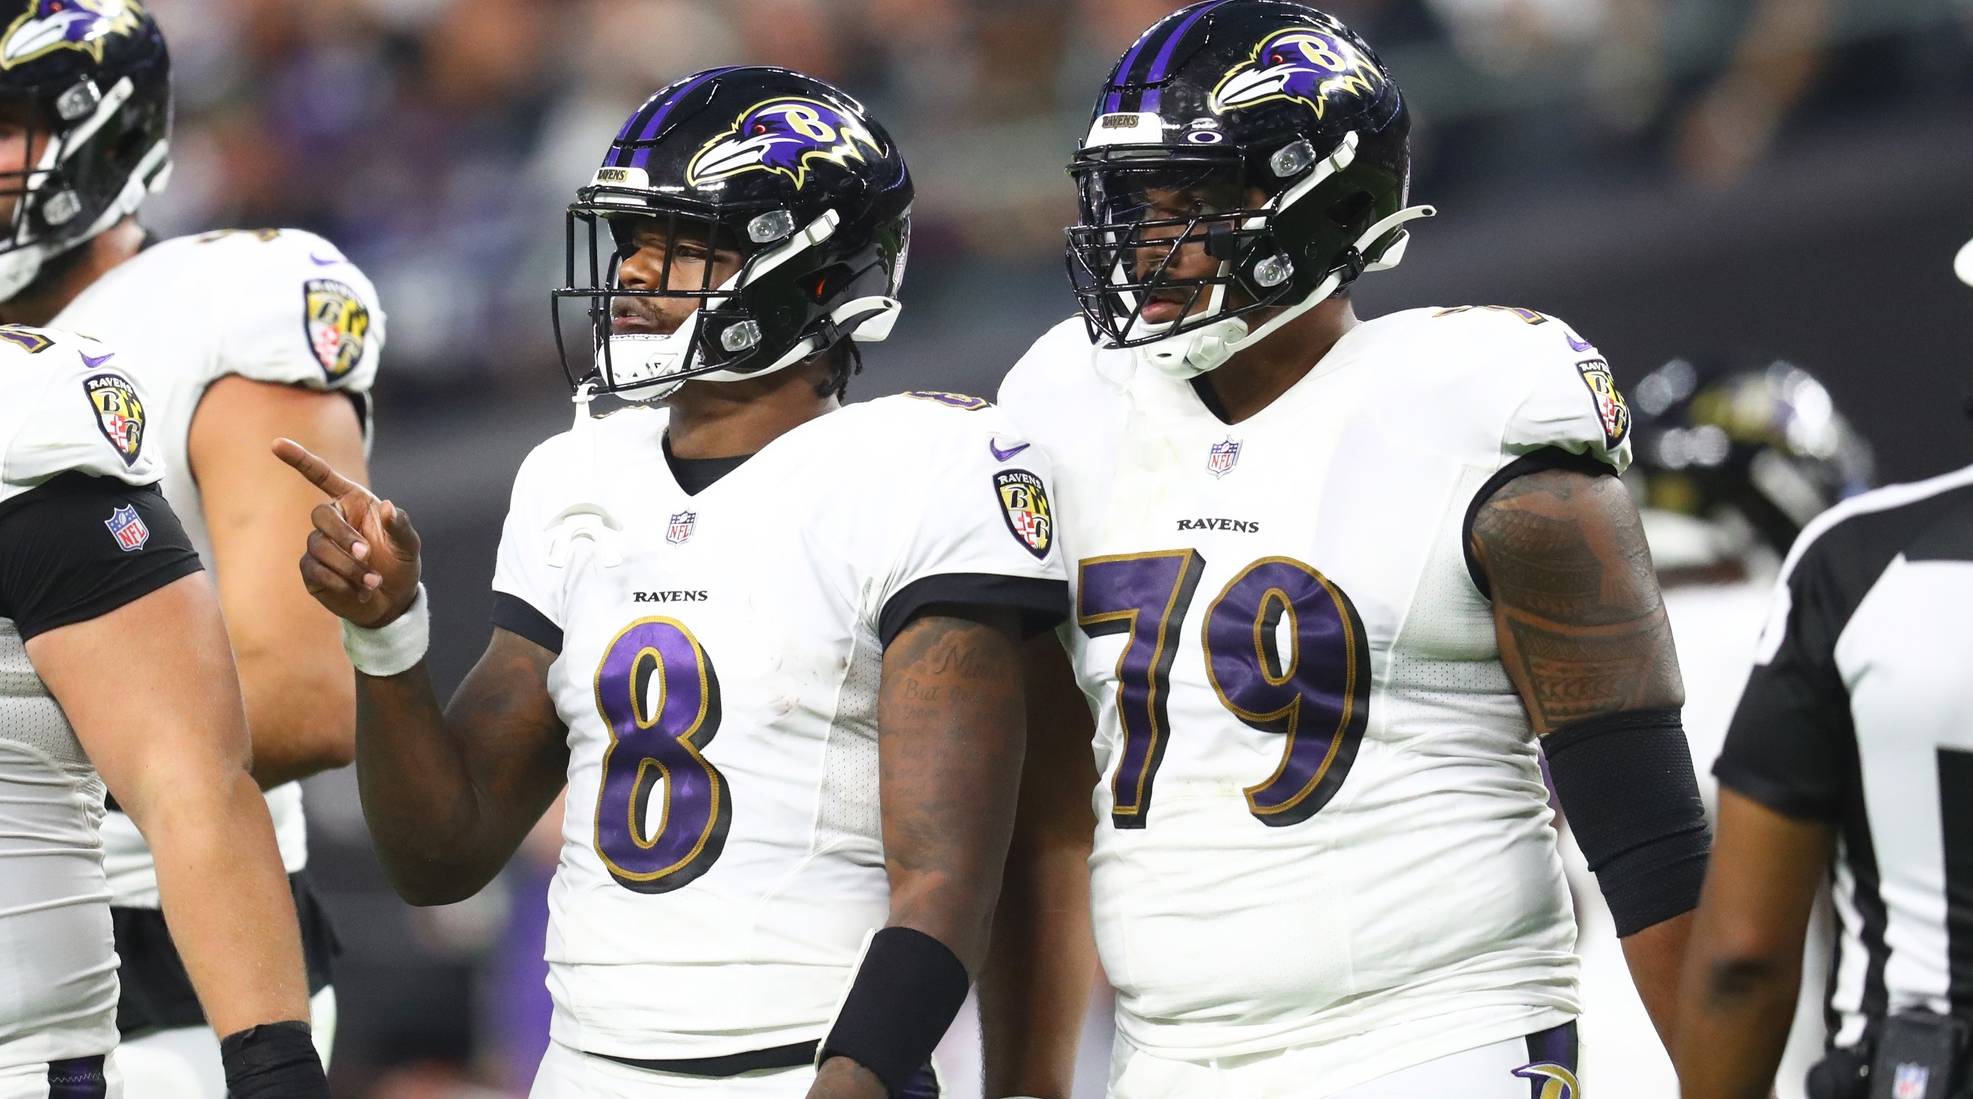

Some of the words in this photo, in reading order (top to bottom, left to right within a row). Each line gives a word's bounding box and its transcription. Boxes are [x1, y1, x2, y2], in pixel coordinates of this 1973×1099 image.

[1271, 34, 1347, 72] B
[757, 104, 836, 142] B
[88, 377, 133, 393] RAVENS
[1211, 454, 1231, 469] NFL
[998, 473, 1042, 489] RAVENS
[1009, 486, 1028, 509] B
[118, 522, 146, 547] NFL
[669, 524, 690, 541] NFL
[1177, 518, 1260, 533] RAVENS
[633, 590, 708, 603] RAVENS
[1078, 548, 1371, 829] 79
[593, 615, 732, 894] 8
